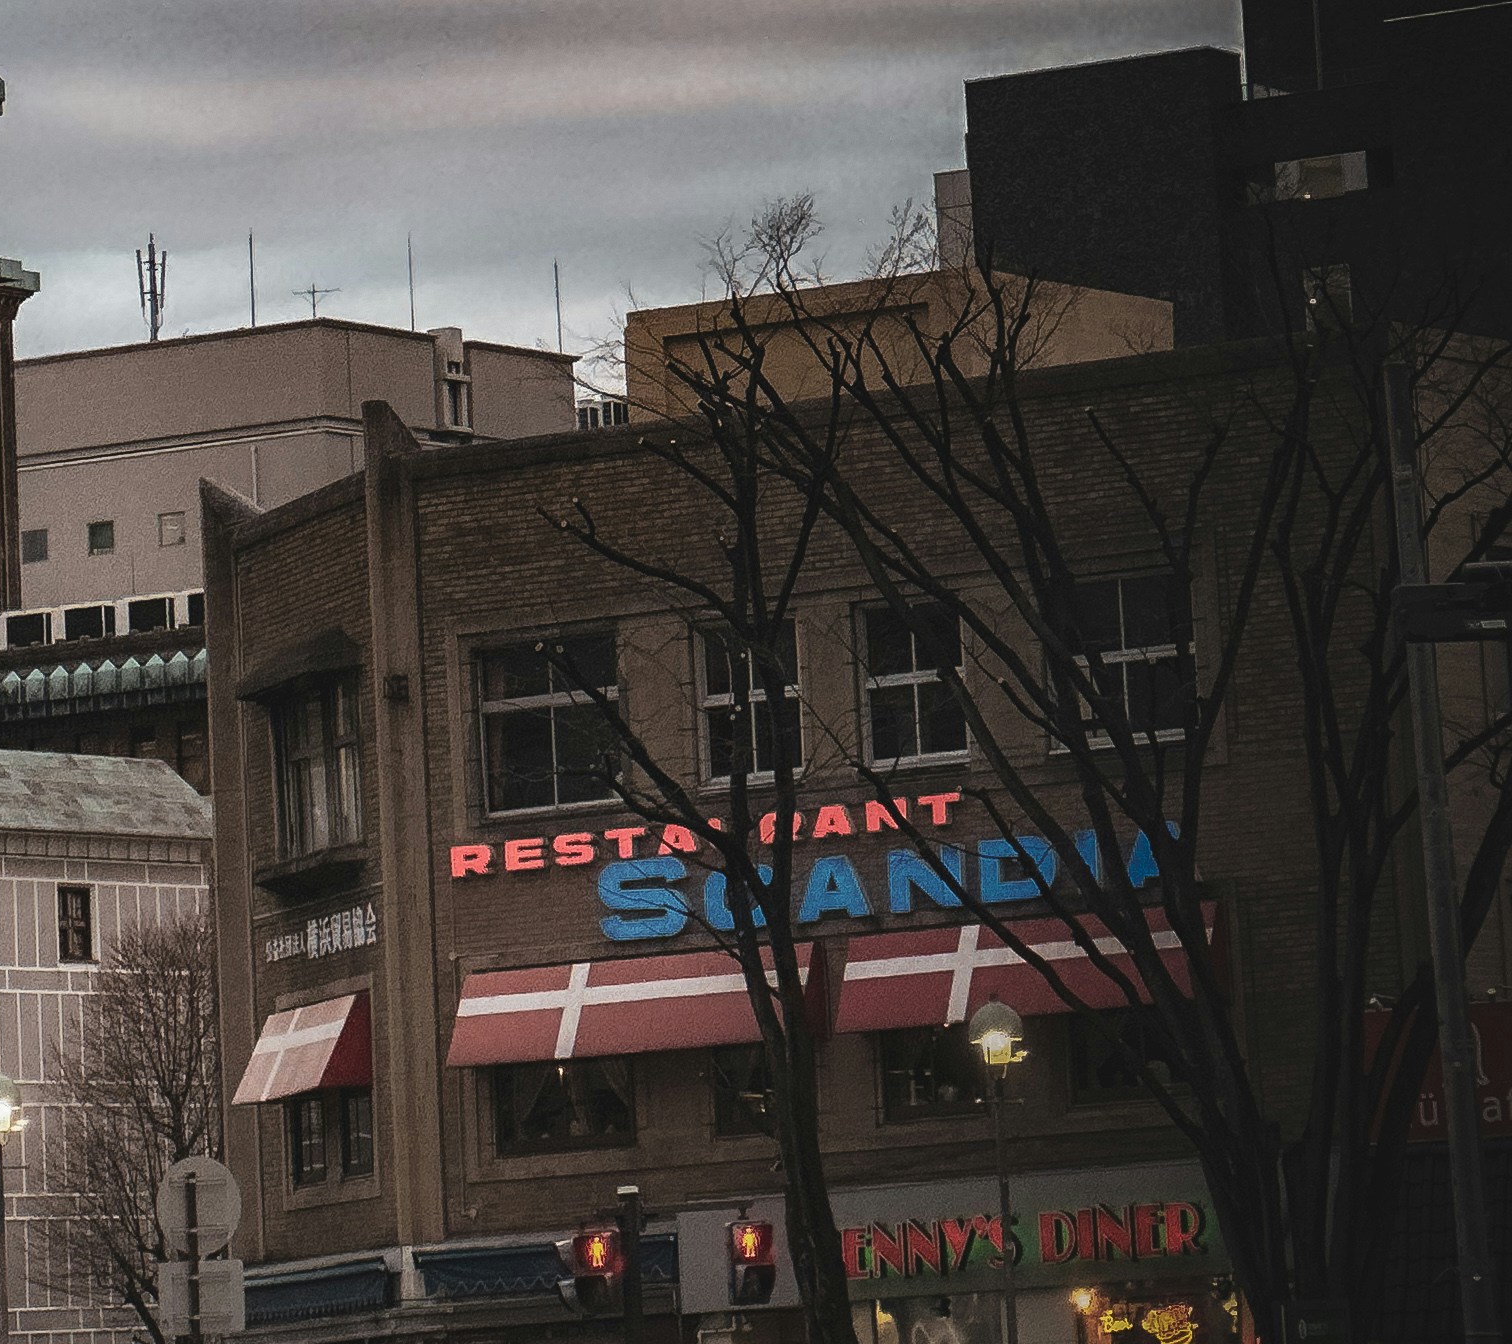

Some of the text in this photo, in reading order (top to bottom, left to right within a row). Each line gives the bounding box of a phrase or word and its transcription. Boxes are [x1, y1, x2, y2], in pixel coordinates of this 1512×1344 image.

[451, 792, 961, 878] RESTARANT
[841, 1202, 1202, 1281] ENNY'S DINER
